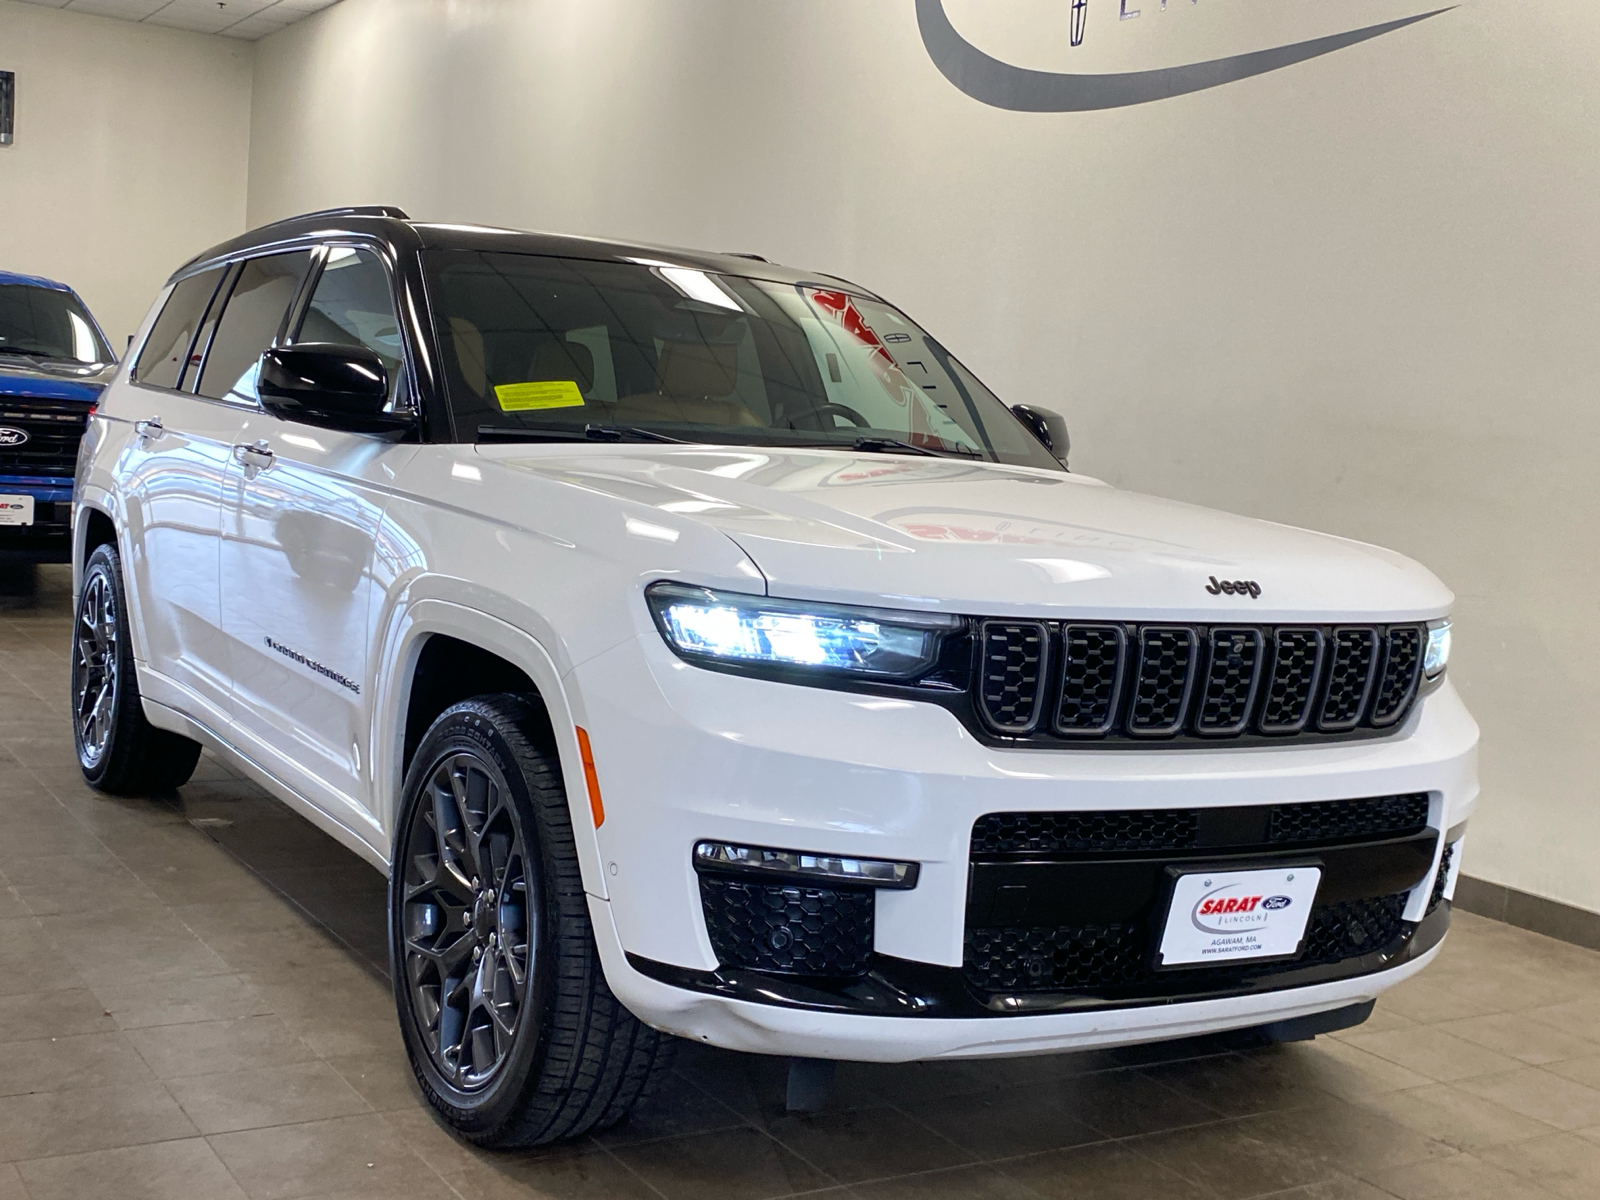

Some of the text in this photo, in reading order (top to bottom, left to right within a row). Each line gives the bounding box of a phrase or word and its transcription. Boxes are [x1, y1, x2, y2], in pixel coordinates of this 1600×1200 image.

[1205, 575, 1261, 599] Jeep
[1199, 896, 1262, 915] SARAT
[1265, 897, 1288, 909] Ford
[1224, 915, 1262, 924] LINCOLN
[1211, 935, 1257, 946] AGAWAM, MA
